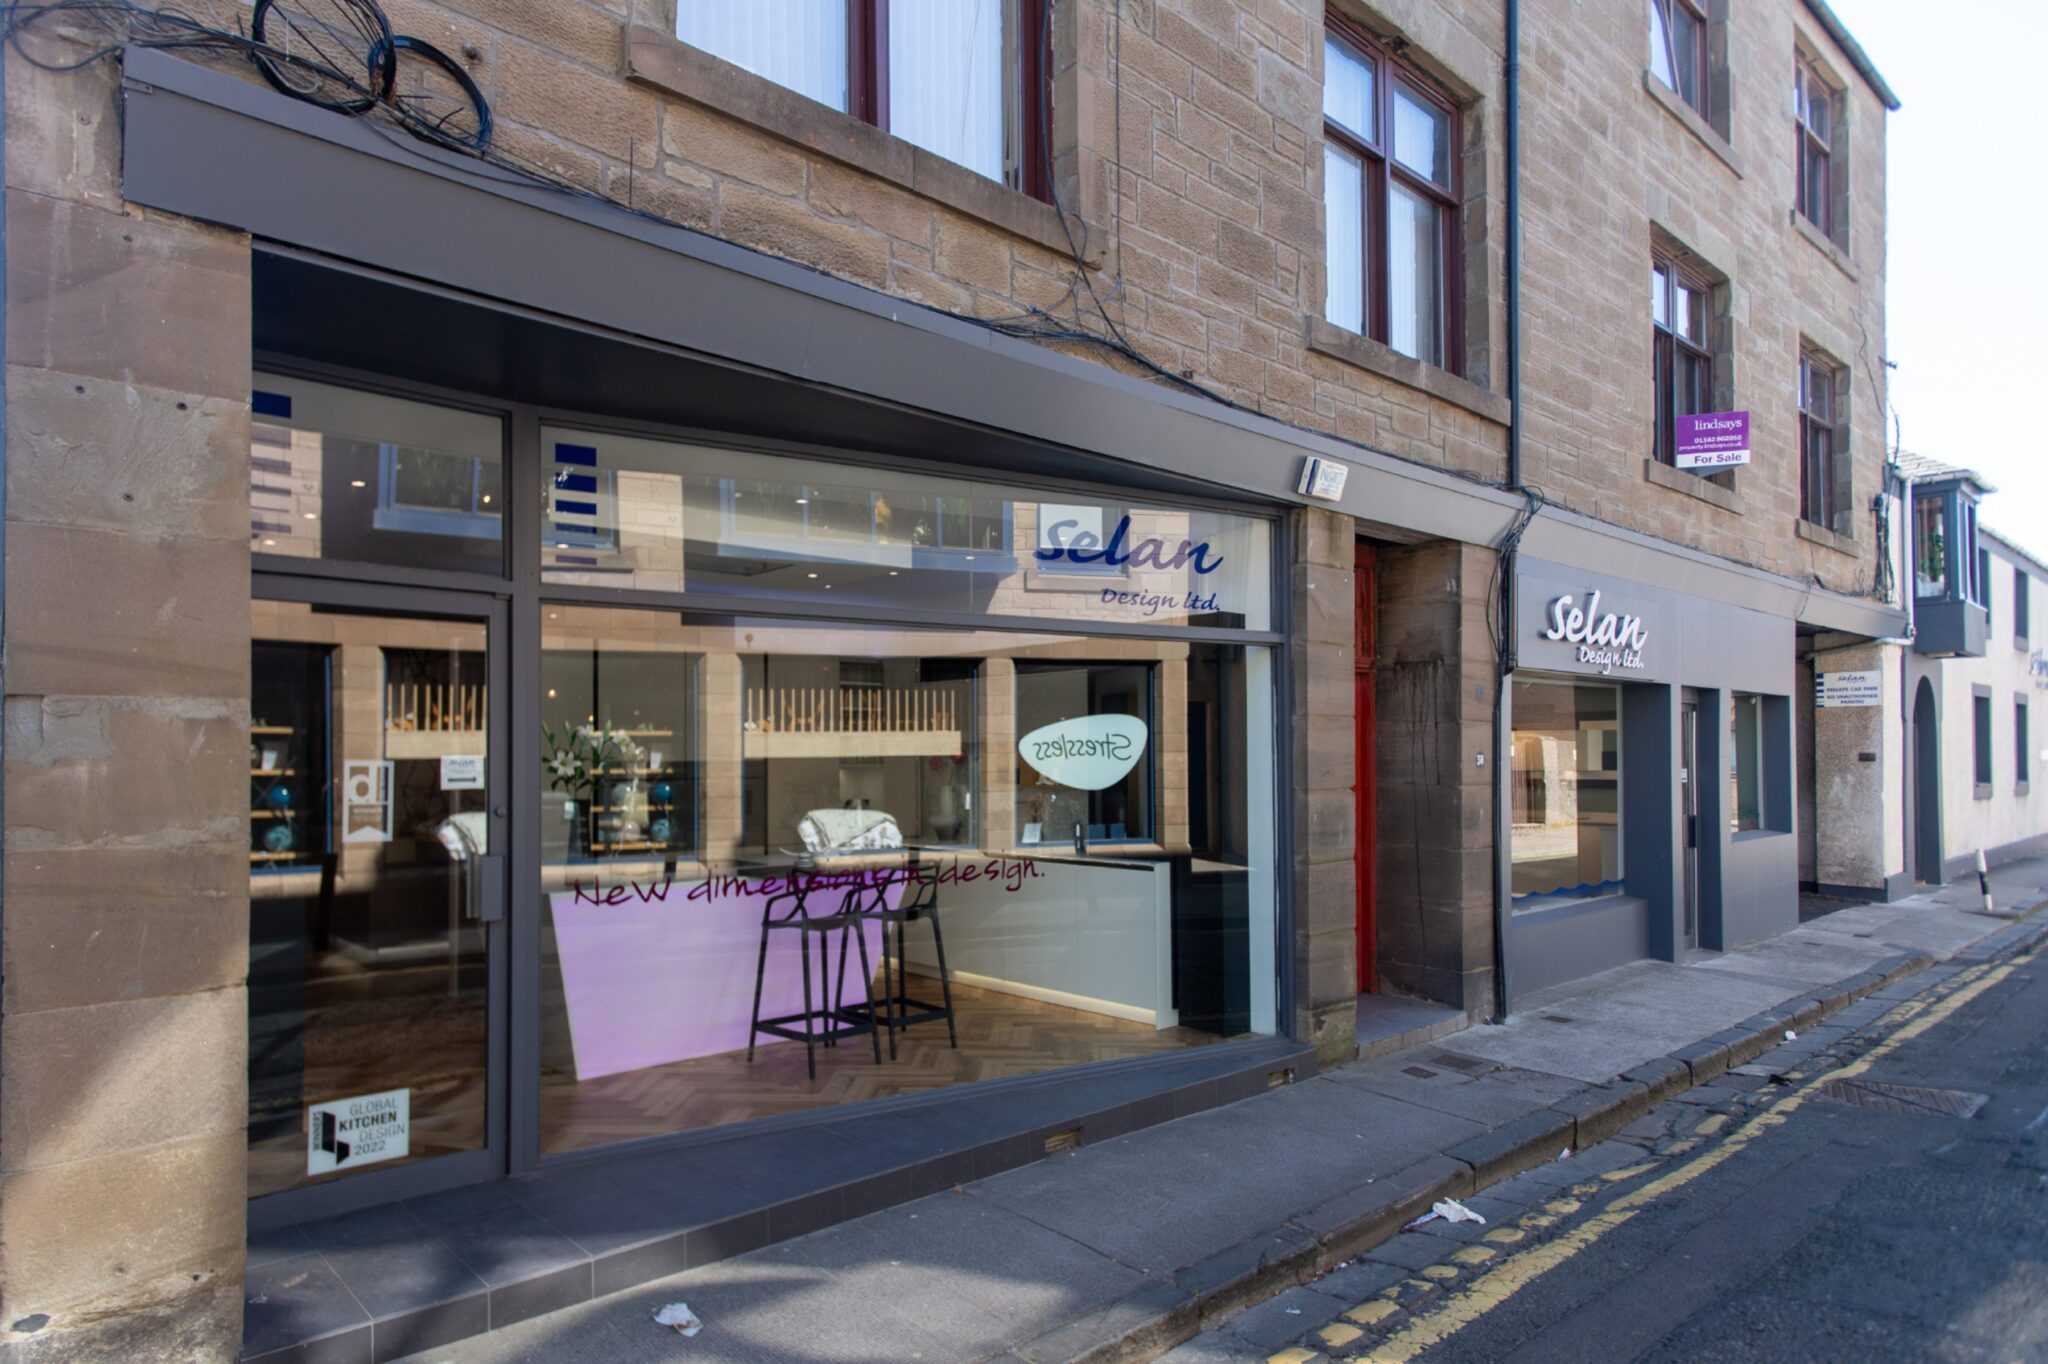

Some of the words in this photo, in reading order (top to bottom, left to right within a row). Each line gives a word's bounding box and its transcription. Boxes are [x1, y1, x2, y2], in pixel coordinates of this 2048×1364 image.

[1695, 419, 1742, 431] lindsays
[1694, 455, 1713, 464] For
[1716, 453, 1742, 463] Sale
[1033, 514, 1224, 575] Selan
[1101, 588, 1178, 616] Design
[1183, 591, 1220, 611] ltd.
[1546, 589, 1649, 651] Selan
[1580, 645, 1622, 675] Design
[687, 857, 888, 904] dimensions
[901, 853, 923, 886] in
[938, 848, 1046, 892] design.
[349, 1098, 399, 1117] GLOBAL
[339, 1110, 397, 1132] KITCHEN
[359, 1123, 405, 1142] DESIGN
[354, 1141, 386, 1156] 2022
